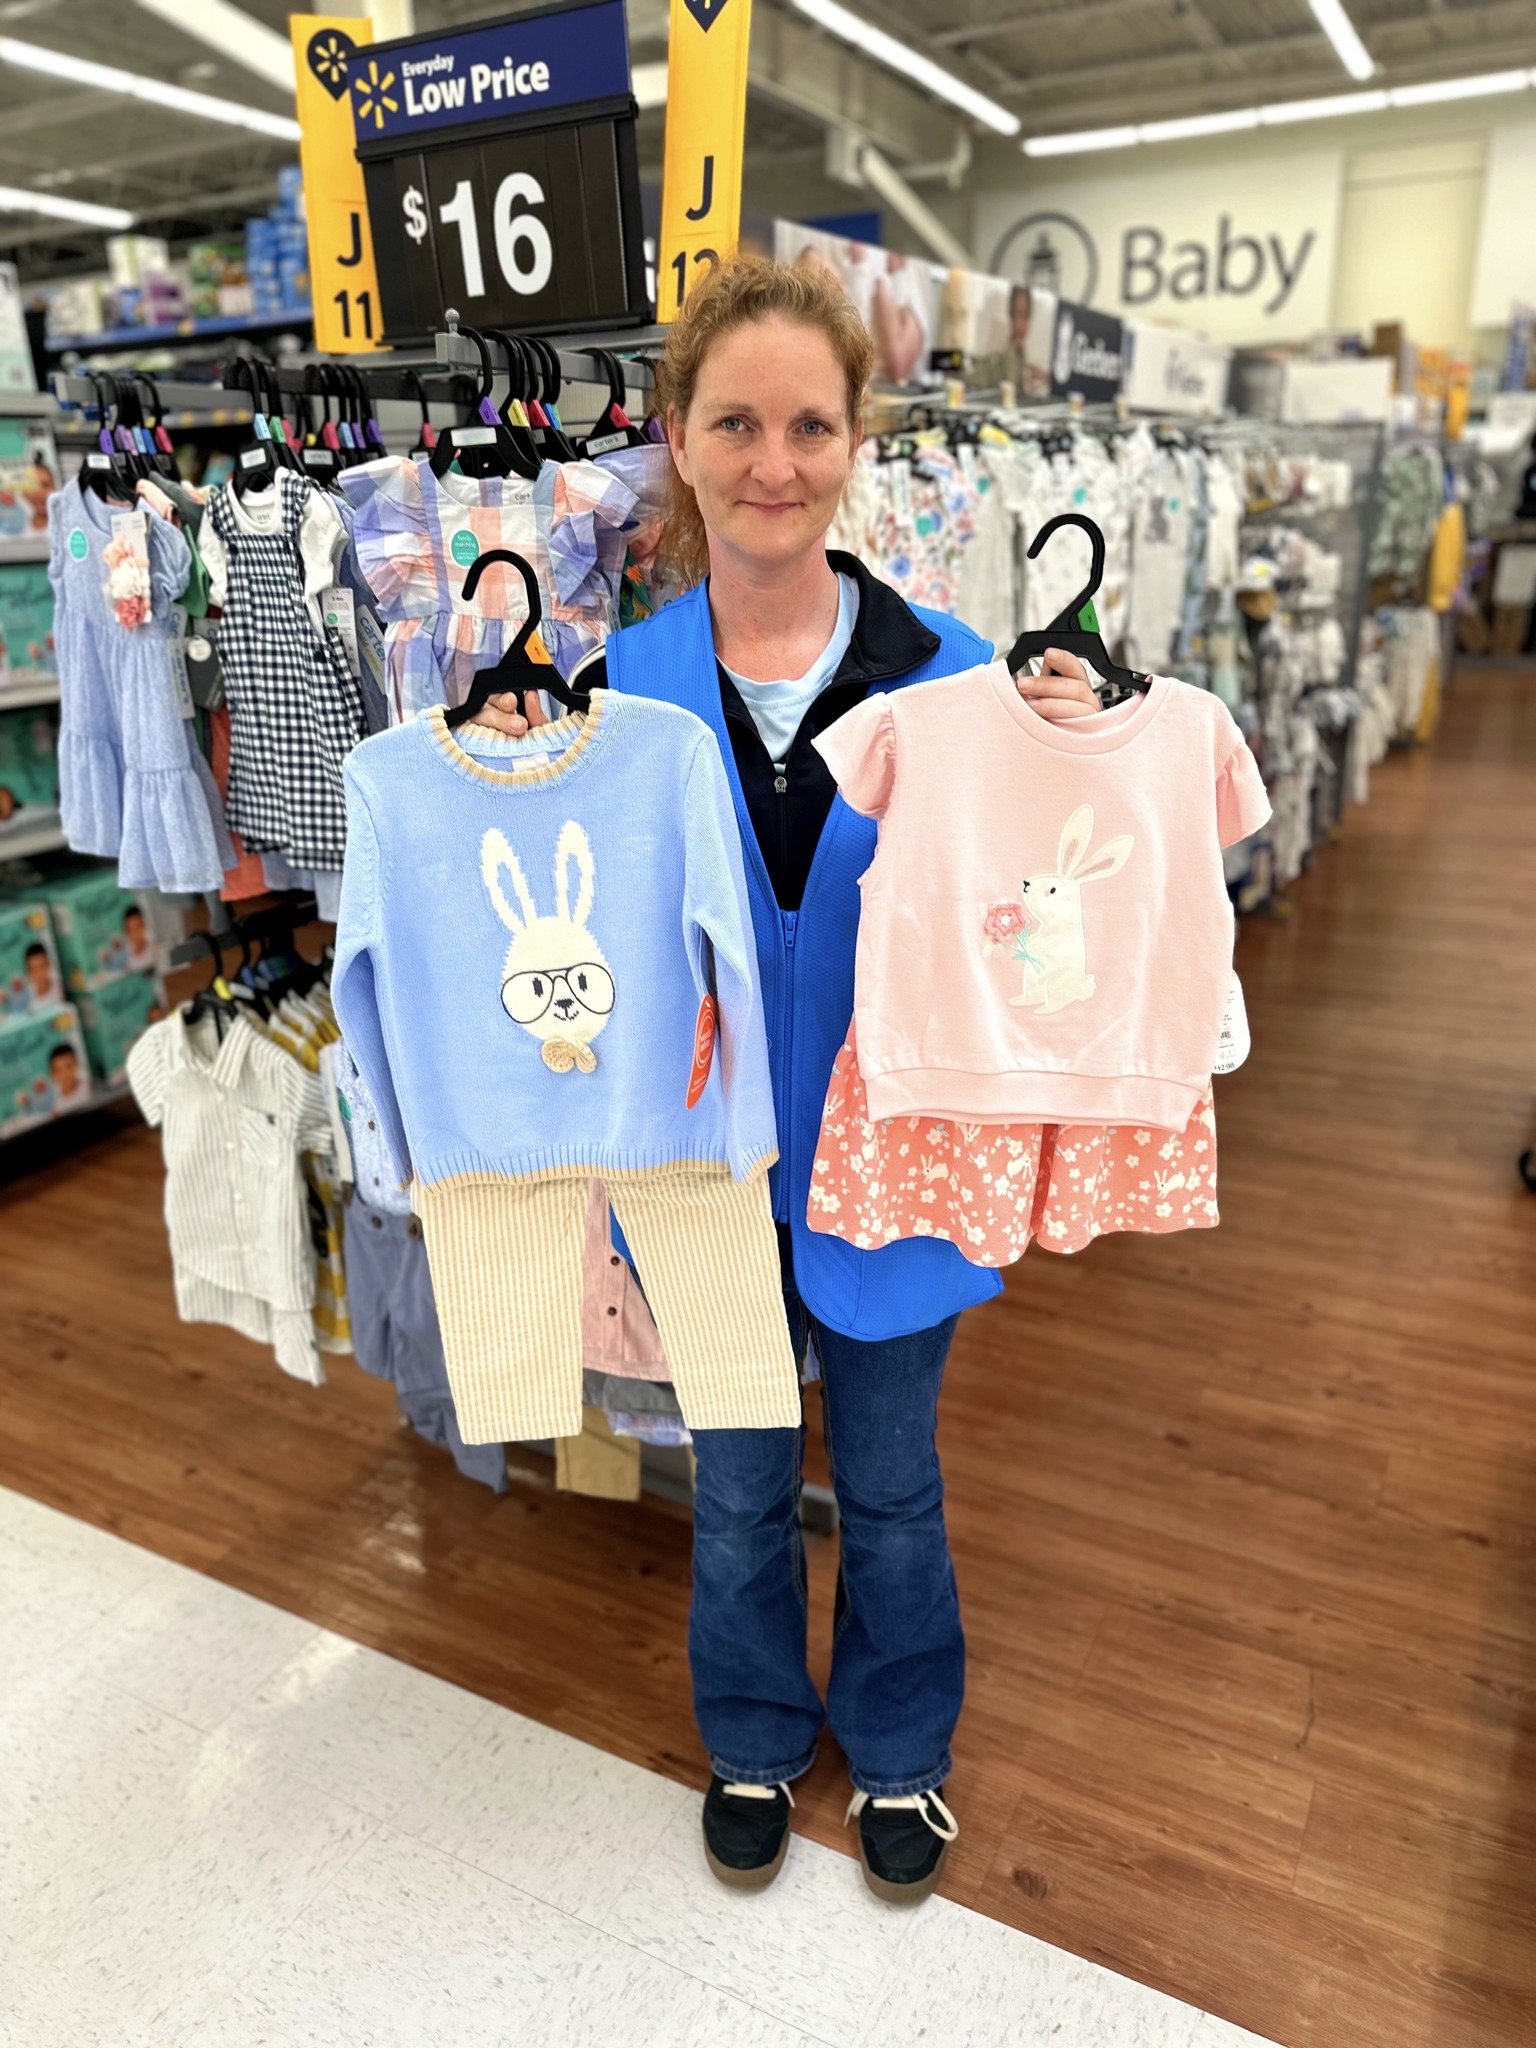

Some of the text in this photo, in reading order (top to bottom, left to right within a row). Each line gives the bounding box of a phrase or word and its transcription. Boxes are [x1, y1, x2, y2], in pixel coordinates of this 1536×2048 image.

[402, 53, 455, 77] Everyday
[403, 57, 551, 117] Low Price
[685, 155, 715, 221] J
[336, 212, 362, 267] J
[1121, 213, 1316, 316] Baby
[333, 289, 374, 340] 11
